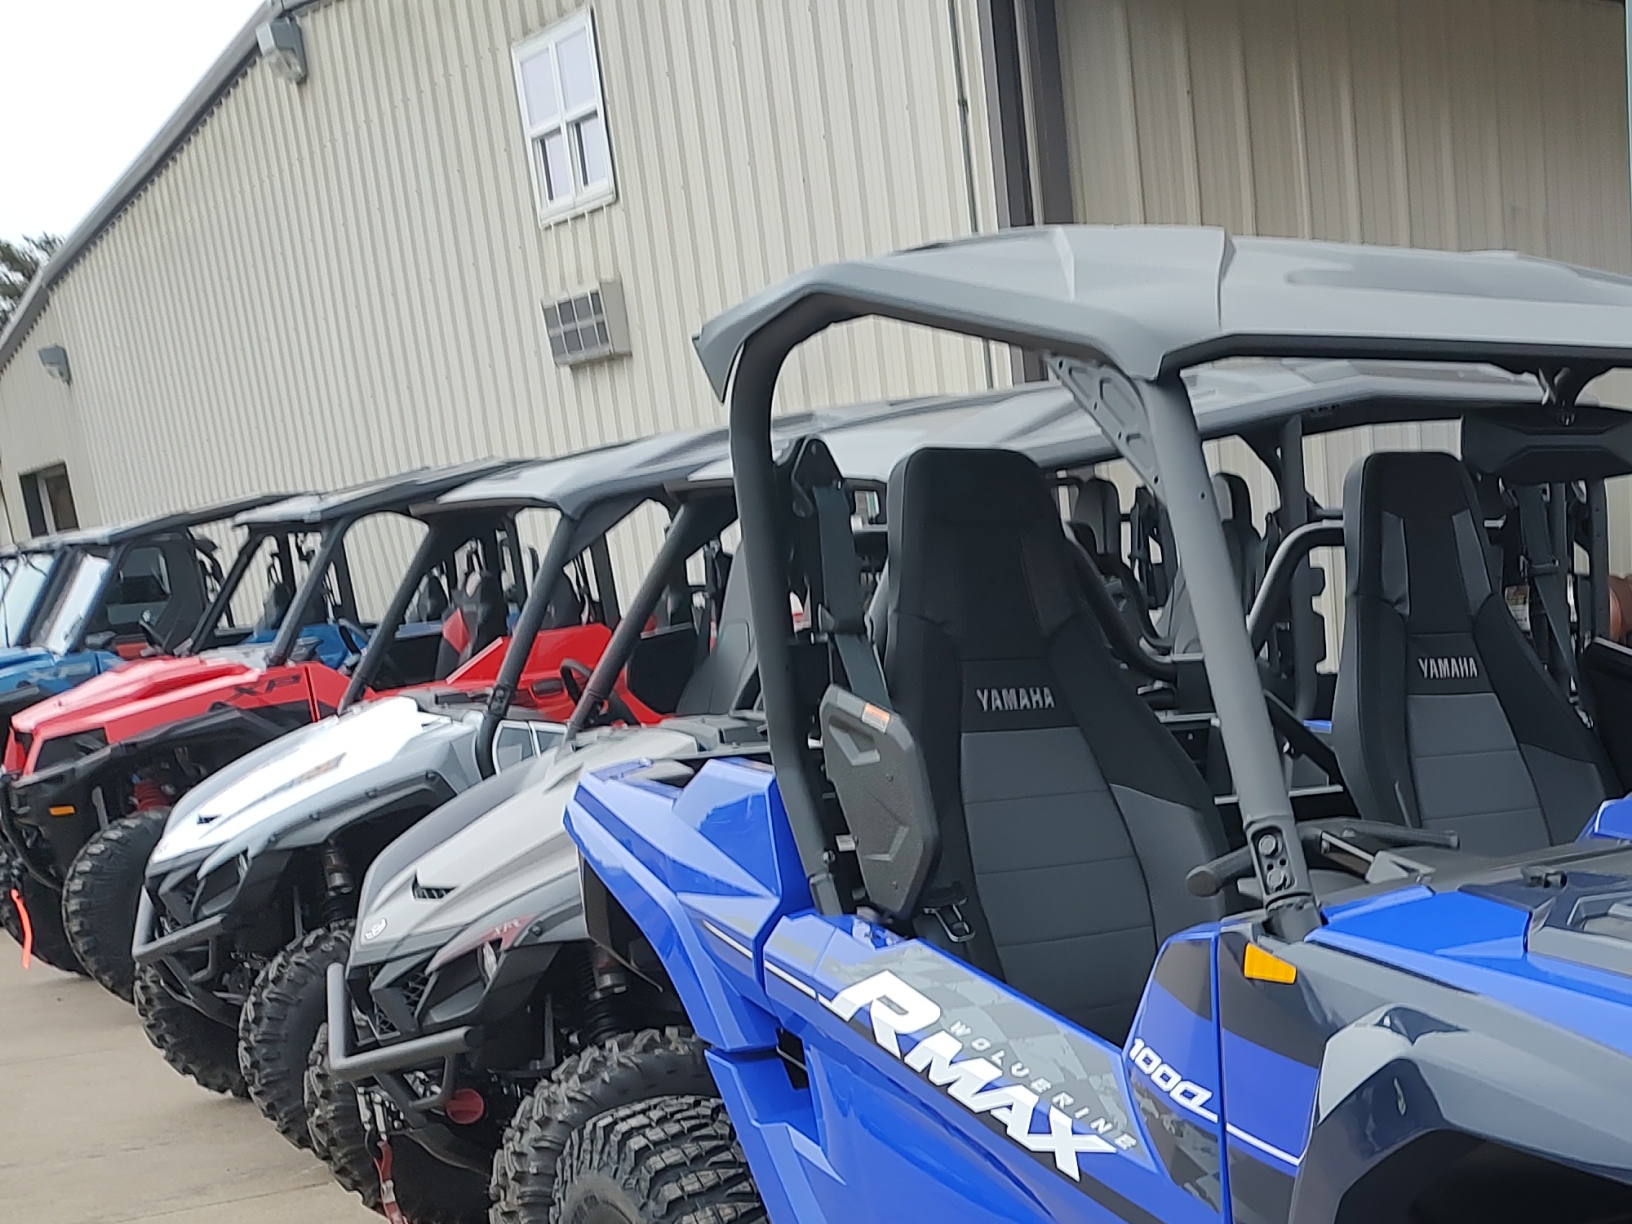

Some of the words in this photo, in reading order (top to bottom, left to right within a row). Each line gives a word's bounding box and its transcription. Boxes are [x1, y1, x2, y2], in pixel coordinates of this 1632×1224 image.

[1417, 656, 1478, 679] YAMAHA
[976, 687, 1055, 712] YAMAHA
[818, 969, 1118, 1182] RMAX
[1129, 1037, 1219, 1124] 1000
